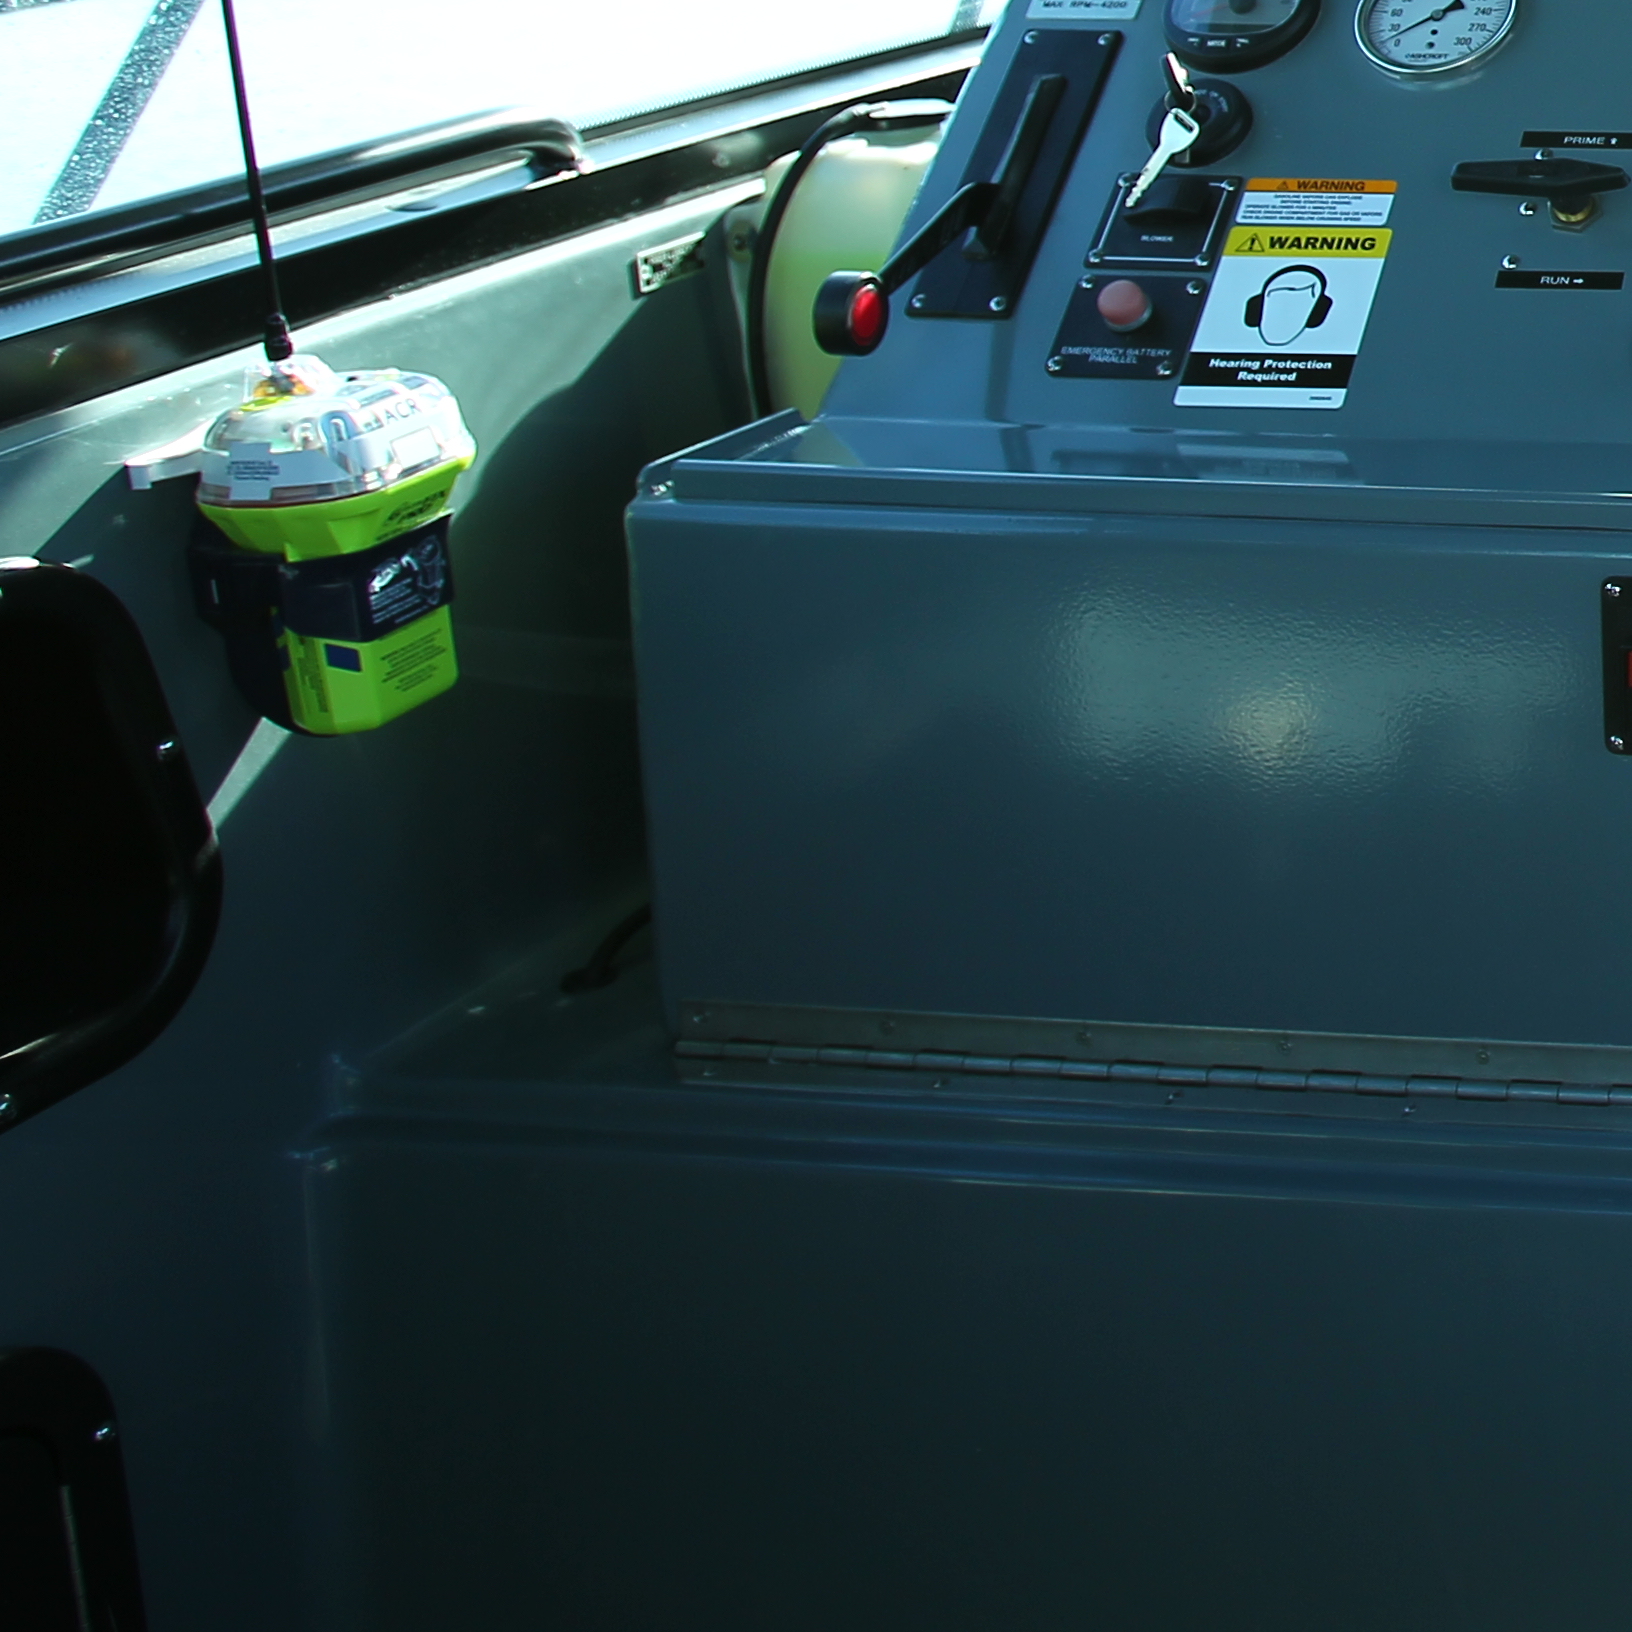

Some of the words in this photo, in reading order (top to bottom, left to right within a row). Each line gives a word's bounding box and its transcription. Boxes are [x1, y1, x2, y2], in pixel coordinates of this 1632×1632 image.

[1042, 0, 1062, 8] MAX
[1390, 8, 1403, 17] 60
[1474, 7, 1492, 15] 240
[1388, 24, 1400, 32] 30
[1468, 24, 1486, 32] 270
[1394, 39, 1400, 47] 0
[1454, 38, 1472, 46] 300
[1564, 136, 1604, 144] PRIME
[1296, 180, 1366, 192] WARNING
[1269, 236, 1376, 251] WARNING
[1540, 276, 1570, 285] RUN
[1060, 346, 1124, 356] EMERGENCY
[1088, 354, 1138, 364] PARALLEL
[1209, 358, 1260, 370] Hearing
[1263, 358, 1332, 370] Protection
[1237, 372, 1298, 382] Required
[384, 398, 422, 425] ACR
